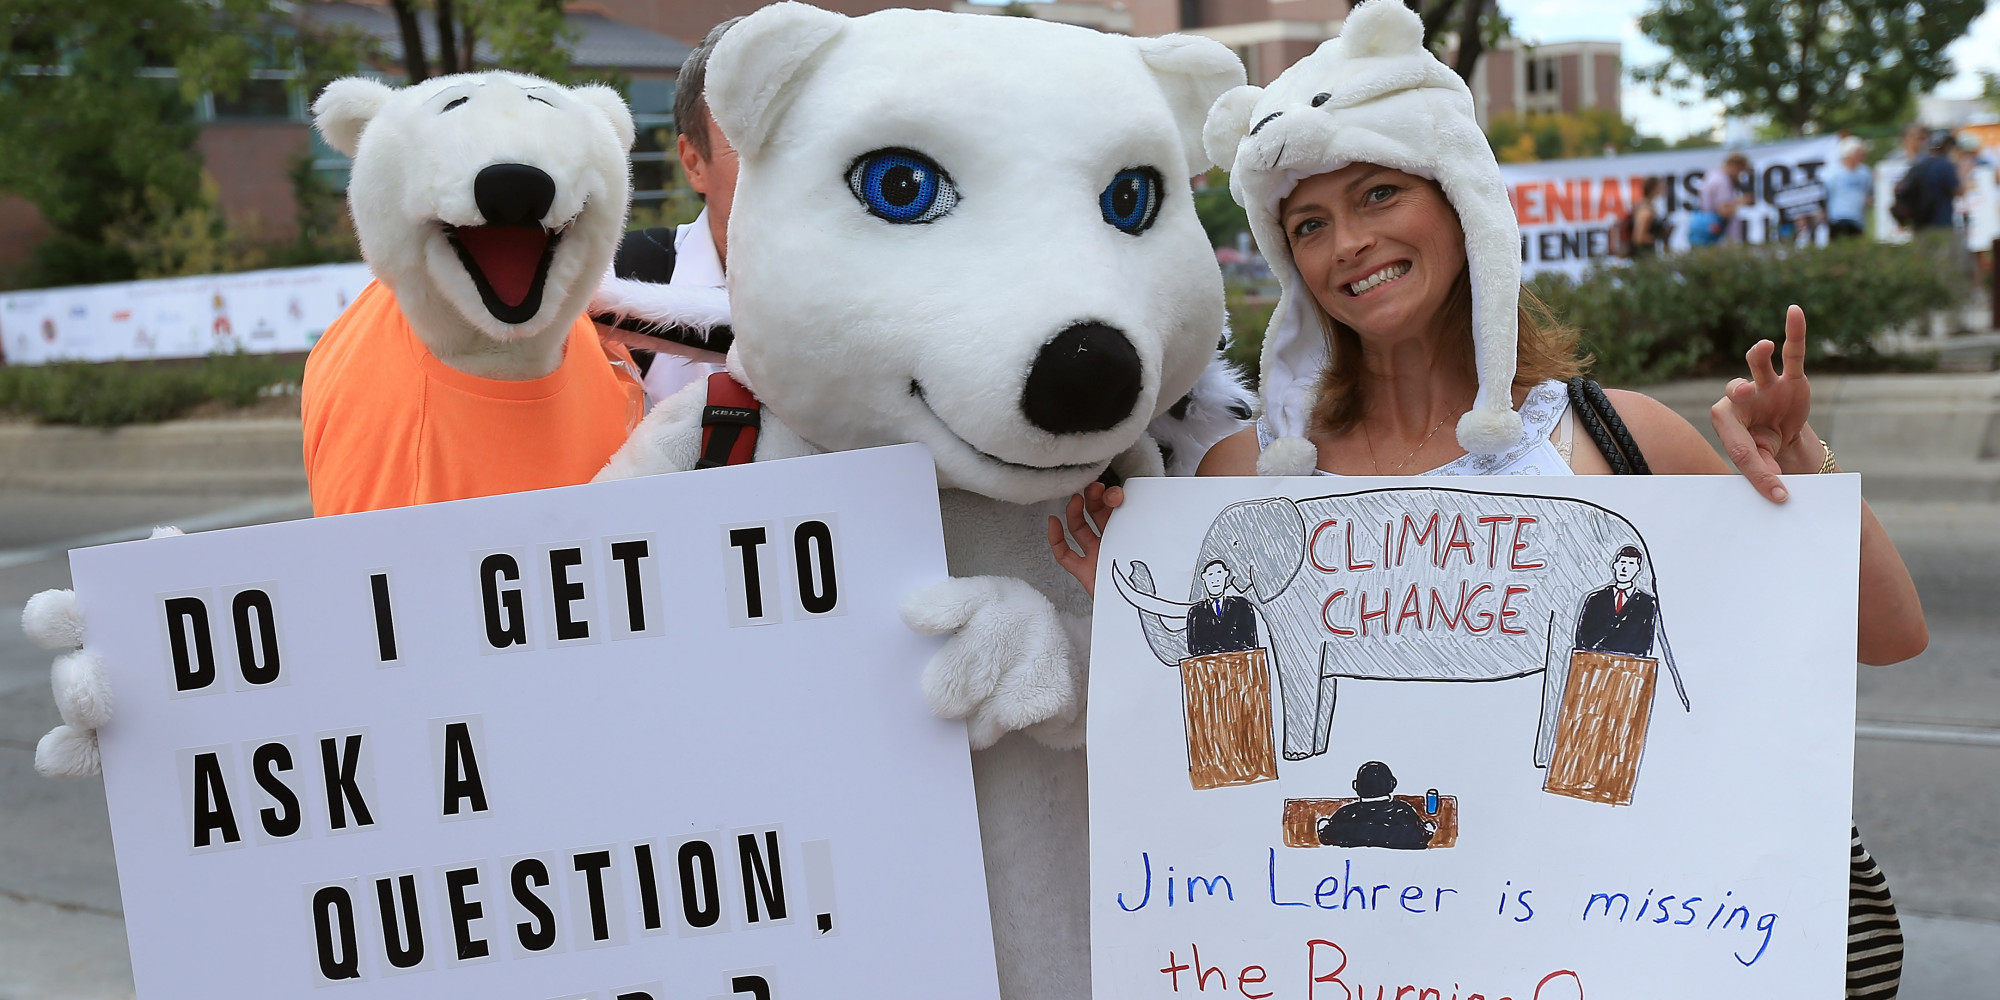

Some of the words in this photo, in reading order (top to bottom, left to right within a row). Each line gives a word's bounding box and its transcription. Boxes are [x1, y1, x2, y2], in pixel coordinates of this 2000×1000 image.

[1509, 175, 1646, 226] ENIA
[711, 409, 750, 417] KELTY
[1309, 512, 1544, 573] CLIMATE
[165, 589, 281, 692] DO
[370, 573, 398, 662] I
[480, 540, 649, 650] GET
[729, 520, 838, 620] TO
[1321, 580, 1529, 637] CHANGE
[193, 734, 375, 848] ASK
[443, 722, 489, 816] A
[312, 830, 833, 981] QUESTION,
[1117, 852, 1234, 912] Jim
[1269, 847, 1458, 914] Lehrer
[1497, 880, 1534, 923] is
[1582, 889, 1779, 968] missing
[1160, 943, 1273, 1000] the
